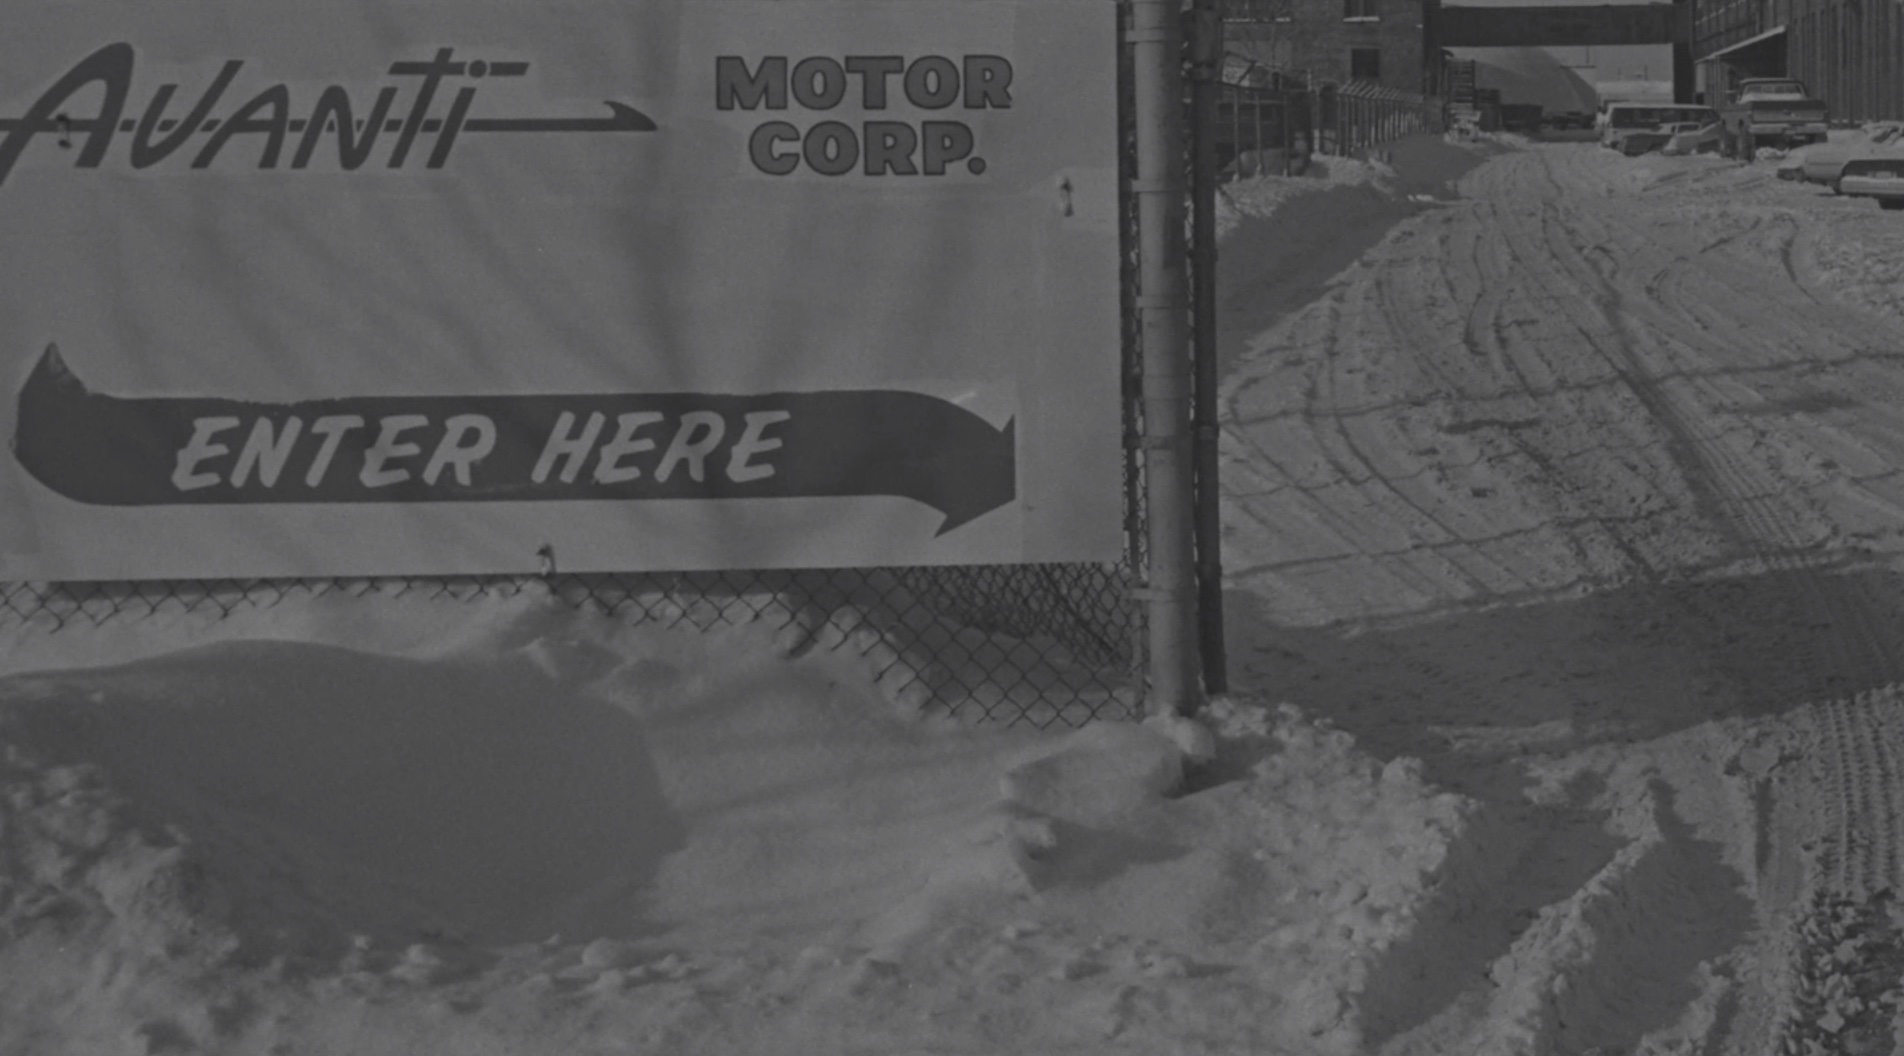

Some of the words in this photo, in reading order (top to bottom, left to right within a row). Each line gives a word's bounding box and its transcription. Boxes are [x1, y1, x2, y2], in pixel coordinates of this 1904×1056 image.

[716, 55, 1013, 110] MOTOR
[748, 120, 987, 176] CORP.
[170, 413, 497, 491] ENTER
[530, 410, 791, 484] HERE
